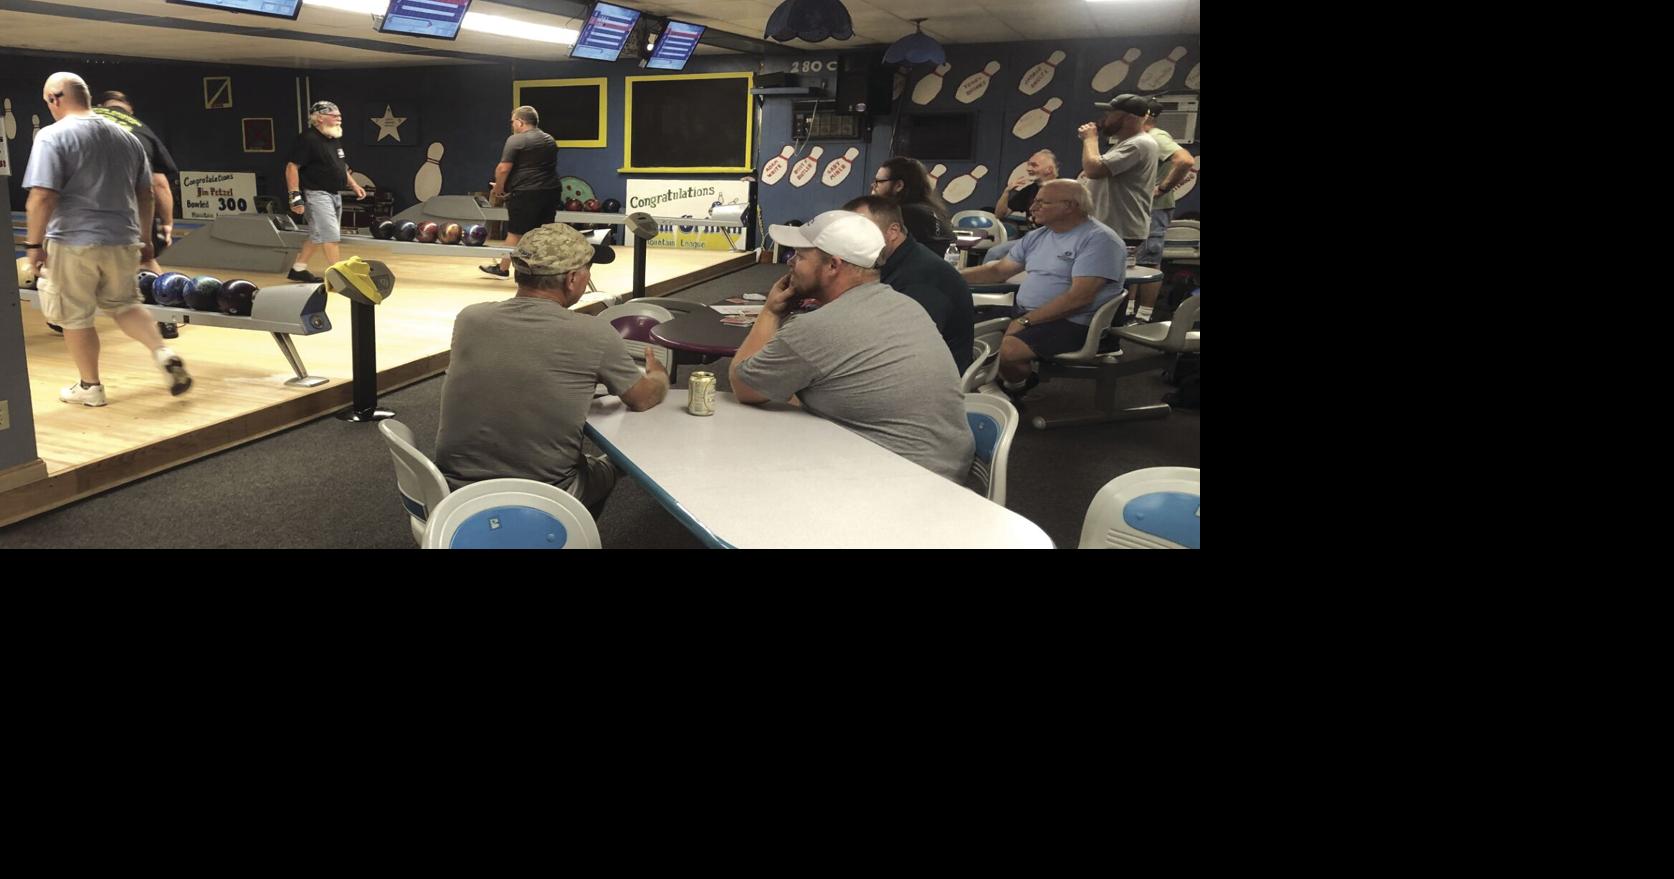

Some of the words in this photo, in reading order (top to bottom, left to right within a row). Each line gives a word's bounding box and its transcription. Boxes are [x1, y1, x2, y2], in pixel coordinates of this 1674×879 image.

[790, 61, 822, 73] 280
[186, 199, 209, 209] Bowled
[218, 197, 247, 211] 300
[630, 186, 715, 209] Congratulations
[647, 239, 676, 247] ountain
